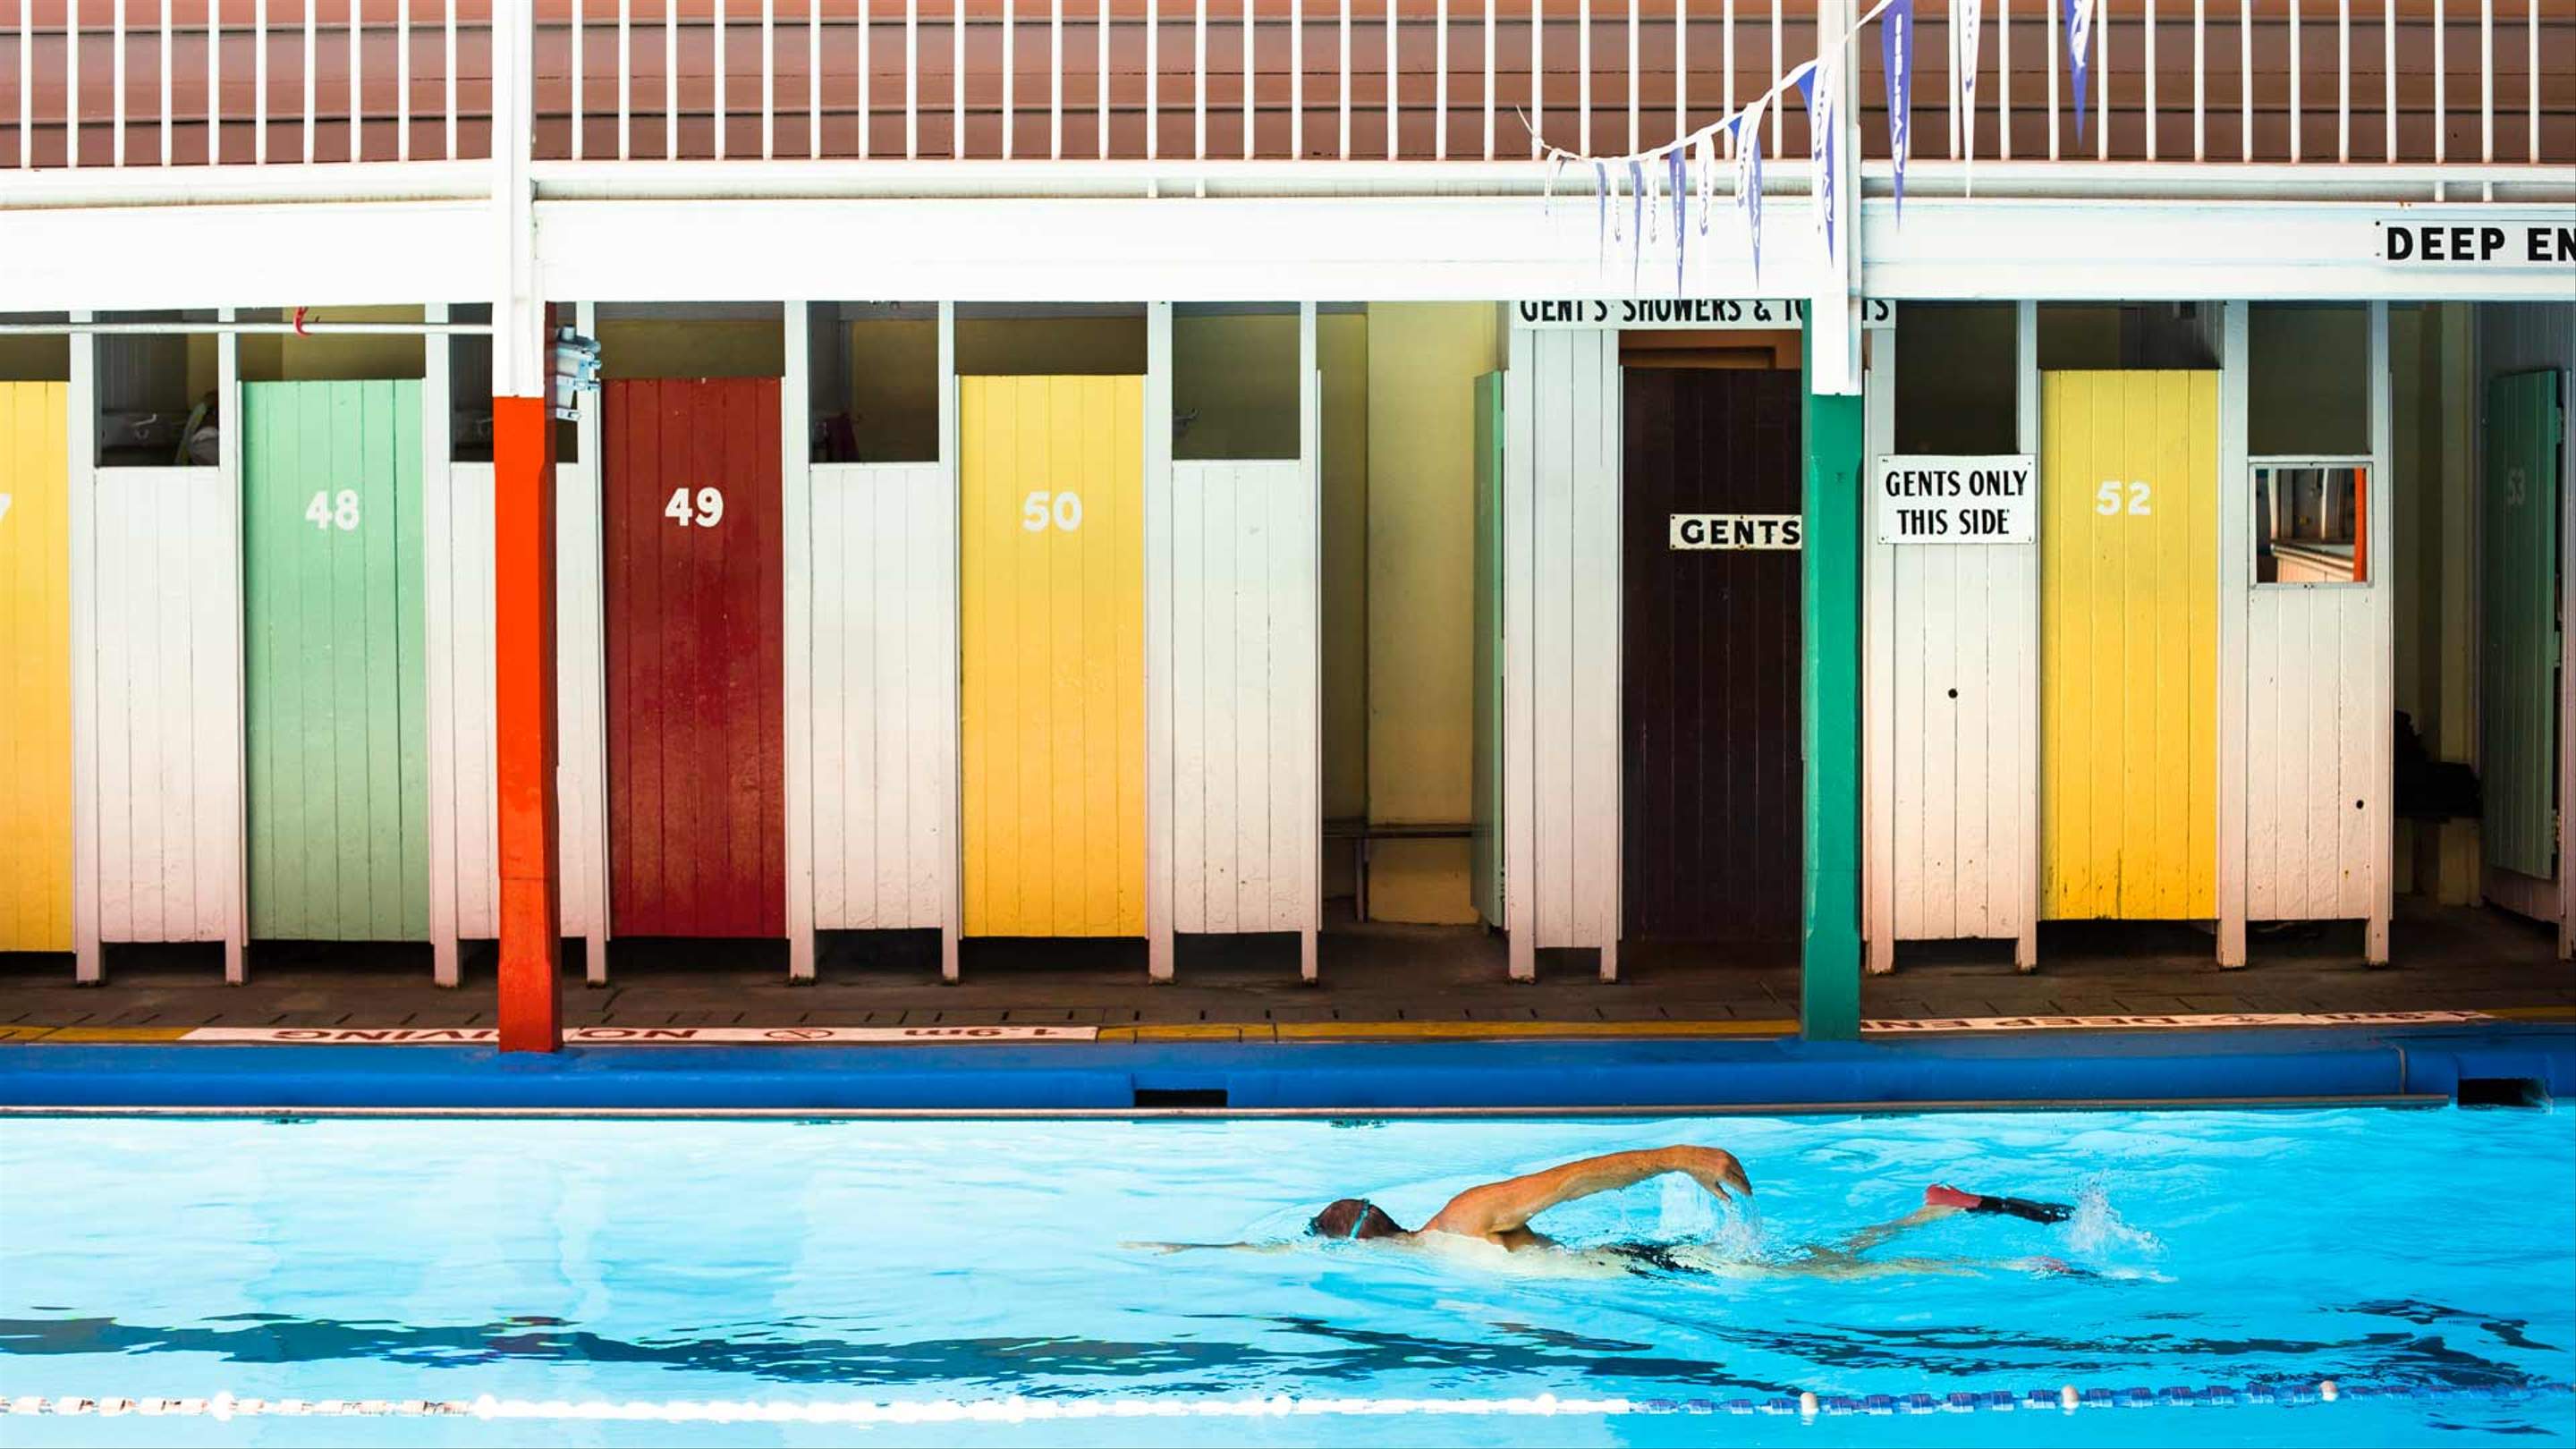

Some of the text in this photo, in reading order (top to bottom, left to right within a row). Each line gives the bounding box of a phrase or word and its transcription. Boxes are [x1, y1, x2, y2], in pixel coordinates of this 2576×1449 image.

[2387, 226, 2505, 261] DEEP
[1885, 470, 2028, 497] GENTS ONLY
[305, 489, 360, 530] 48
[665, 487, 724, 528] 49
[1022, 490, 1082, 532] 50
[2095, 479, 2152, 516] 52
[1681, 520, 1801, 545] GENTS
[1896, 509, 2011, 535] THIS SIDE
[579, 1030, 699, 1038] NO
[1995, 1016, 2180, 1026] DEEP
[271, 1030, 500, 1040] IVING
